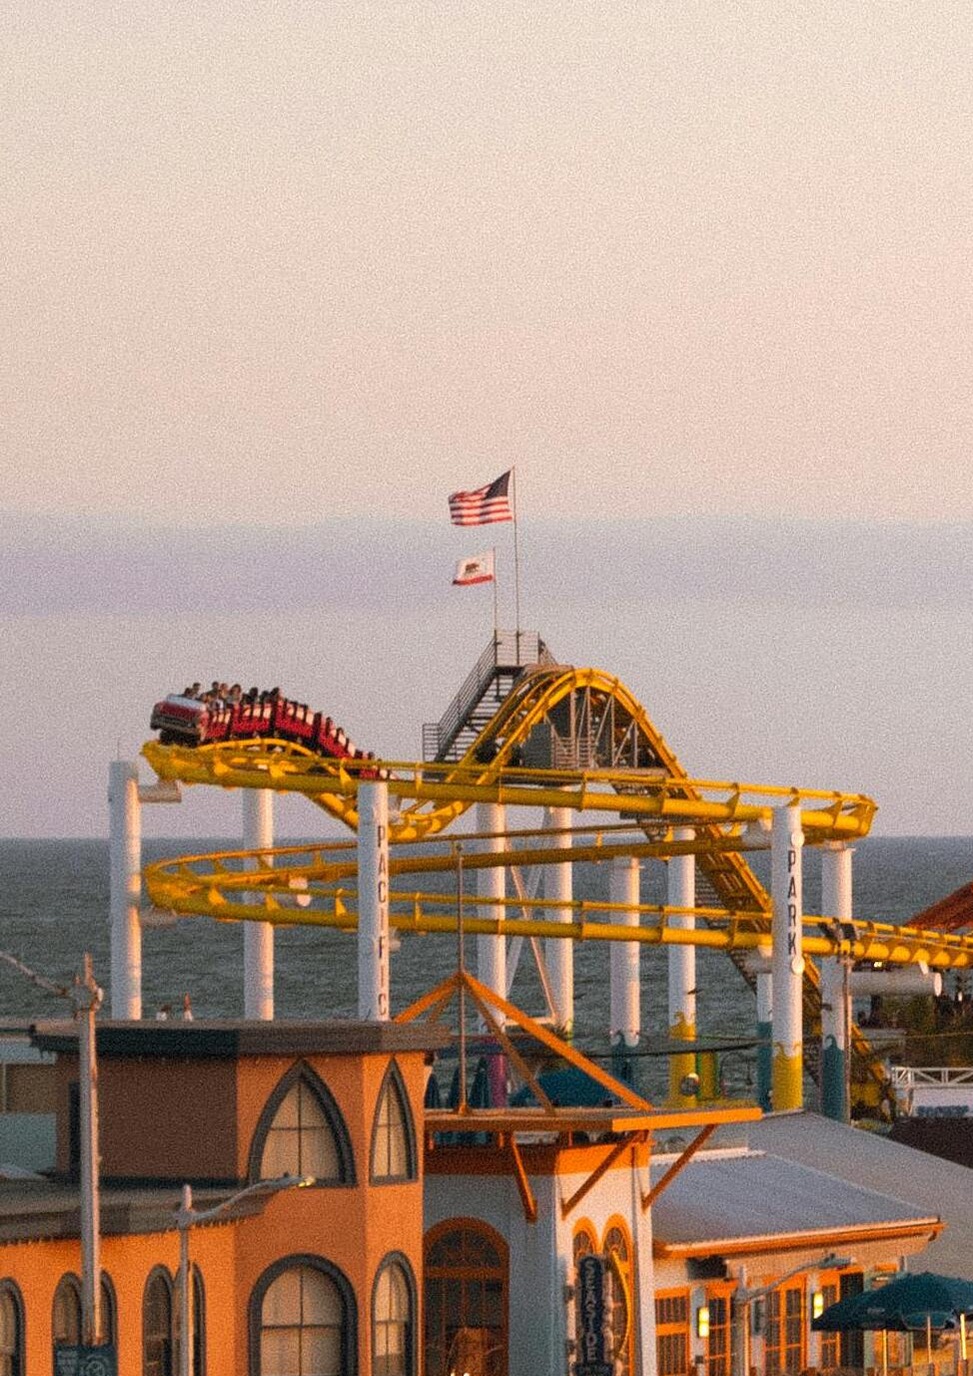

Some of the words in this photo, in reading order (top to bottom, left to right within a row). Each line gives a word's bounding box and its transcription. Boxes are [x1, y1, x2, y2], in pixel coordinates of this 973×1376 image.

[377, 825, 387, 1016] PACIFIC
[787, 849, 797, 956] PARK
[584, 1260, 597, 1361] SEASIDE
